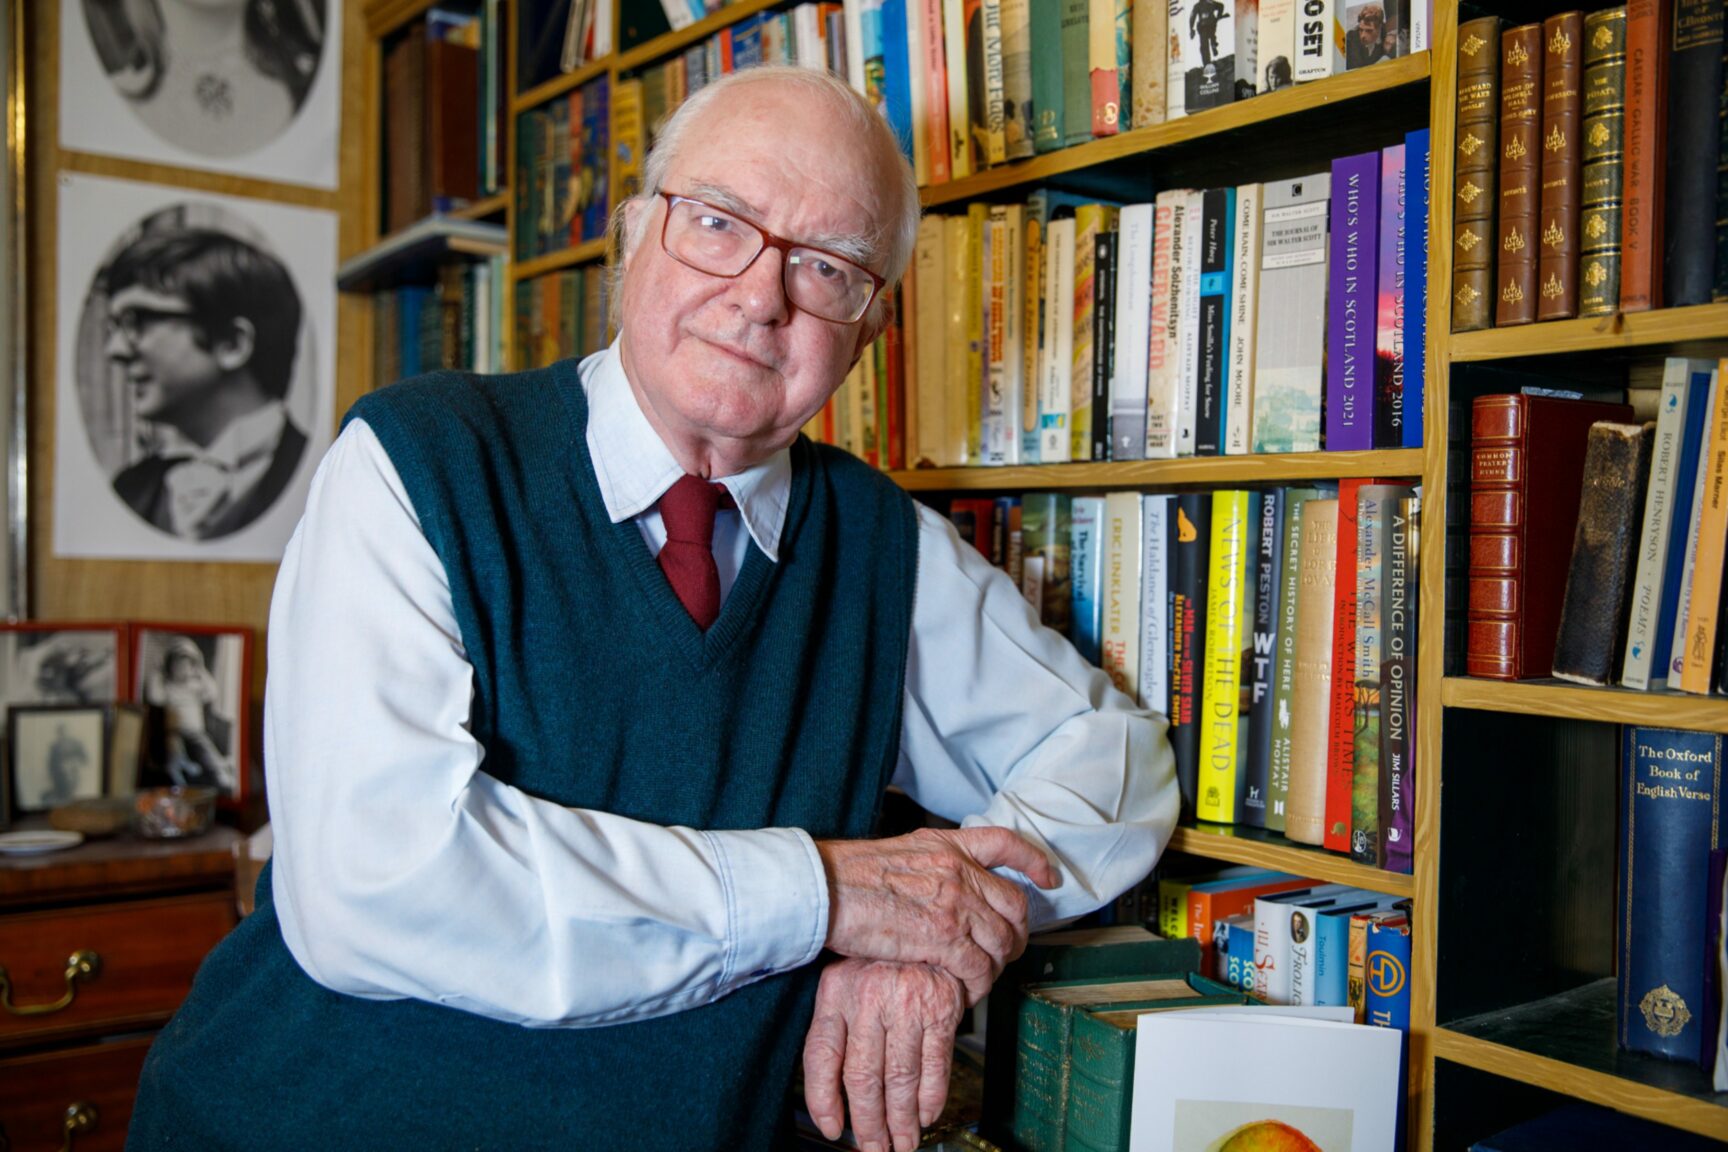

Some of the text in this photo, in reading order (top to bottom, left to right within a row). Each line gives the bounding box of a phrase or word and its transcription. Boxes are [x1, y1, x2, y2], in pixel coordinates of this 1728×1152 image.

[986, 37, 1003, 83] More
[1303, 21, 1323, 56] SET
[1632, 48, 1644, 99] CAESAR
[987, 88, 1006, 135] Flags
[1631, 108, 1642, 156] GALLIC
[1630, 159, 1641, 188] WAR
[1208, 219, 1219, 239] Peter
[1278, 236, 1302, 244] WALTER
[1303, 233, 1321, 241] SCOTT
[1628, 197, 1640, 234] BOOK
[1167, 205, 1185, 339] Alexander Solzhenitsyn
[1237, 199, 1251, 327] COME RAIN, COME SHINE
[1149, 206, 1171, 370] CANCER WARD
[1342, 173, 1359, 427] WHO'S WHO IN SCOTLAND 2021
[1204, 305, 1216, 419] Miss Smilla's Feeling for Snow
[1392, 296, 1404, 387] SCOTLAND
[1234, 336, 1245, 409] JOHN MOORE
[1391, 391, 1403, 427] 2016
[1711, 450, 1726, 510] Silas Marner
[1079, 530, 1088, 550] The
[1219, 518, 1243, 589] NEWS
[1289, 526, 1300, 573] SECRET
[1636, 432, 1673, 635] ROBERT HENRYSON POEMS
[1077, 553, 1088, 603] Survival
[1110, 517, 1122, 634] ERIC LINKLATER
[1258, 494, 1276, 625] ROBERT PESTON
[1143, 512, 1160, 702] The Haldanes of Gleneagles
[1285, 577, 1297, 633] HISTORY
[1361, 500, 1378, 678] Alexander McCall Smith
[1183, 608, 1195, 633] MAN
[1218, 599, 1238, 631] OF
[1337, 600, 1347, 677] INTRODUCTION
[1390, 515, 1405, 740] A DIFFERENCE OF OPINION
[1114, 640, 1126, 670] THE
[1172, 594, 1186, 726] ALEXANDER McCALL SMITH
[1204, 587, 1218, 701] JAMES ROBERTSON
[1284, 636, 1293, 655] OF
[1180, 659, 1193, 693] SILVER
[1282, 659, 1292, 691] HERE
[1180, 696, 1192, 724] SAAB
[1333, 692, 1343, 739] MALCOLM
[1211, 702, 1234, 772] DEAD
[1341, 728, 1354, 792] TIMES
[1638, 745, 1712, 763] The Oxford
[1272, 739, 1281, 788] MOFFAT
[1281, 737, 1291, 792] ALISTAIR
[1391, 752, 1401, 811] JIM SILLARS
[1649, 764, 1700, 781] Book of
[1637, 782, 1711, 801] English Verse
[1194, 903, 1204, 921] The
[1318, 935, 1327, 976] Toulmin
